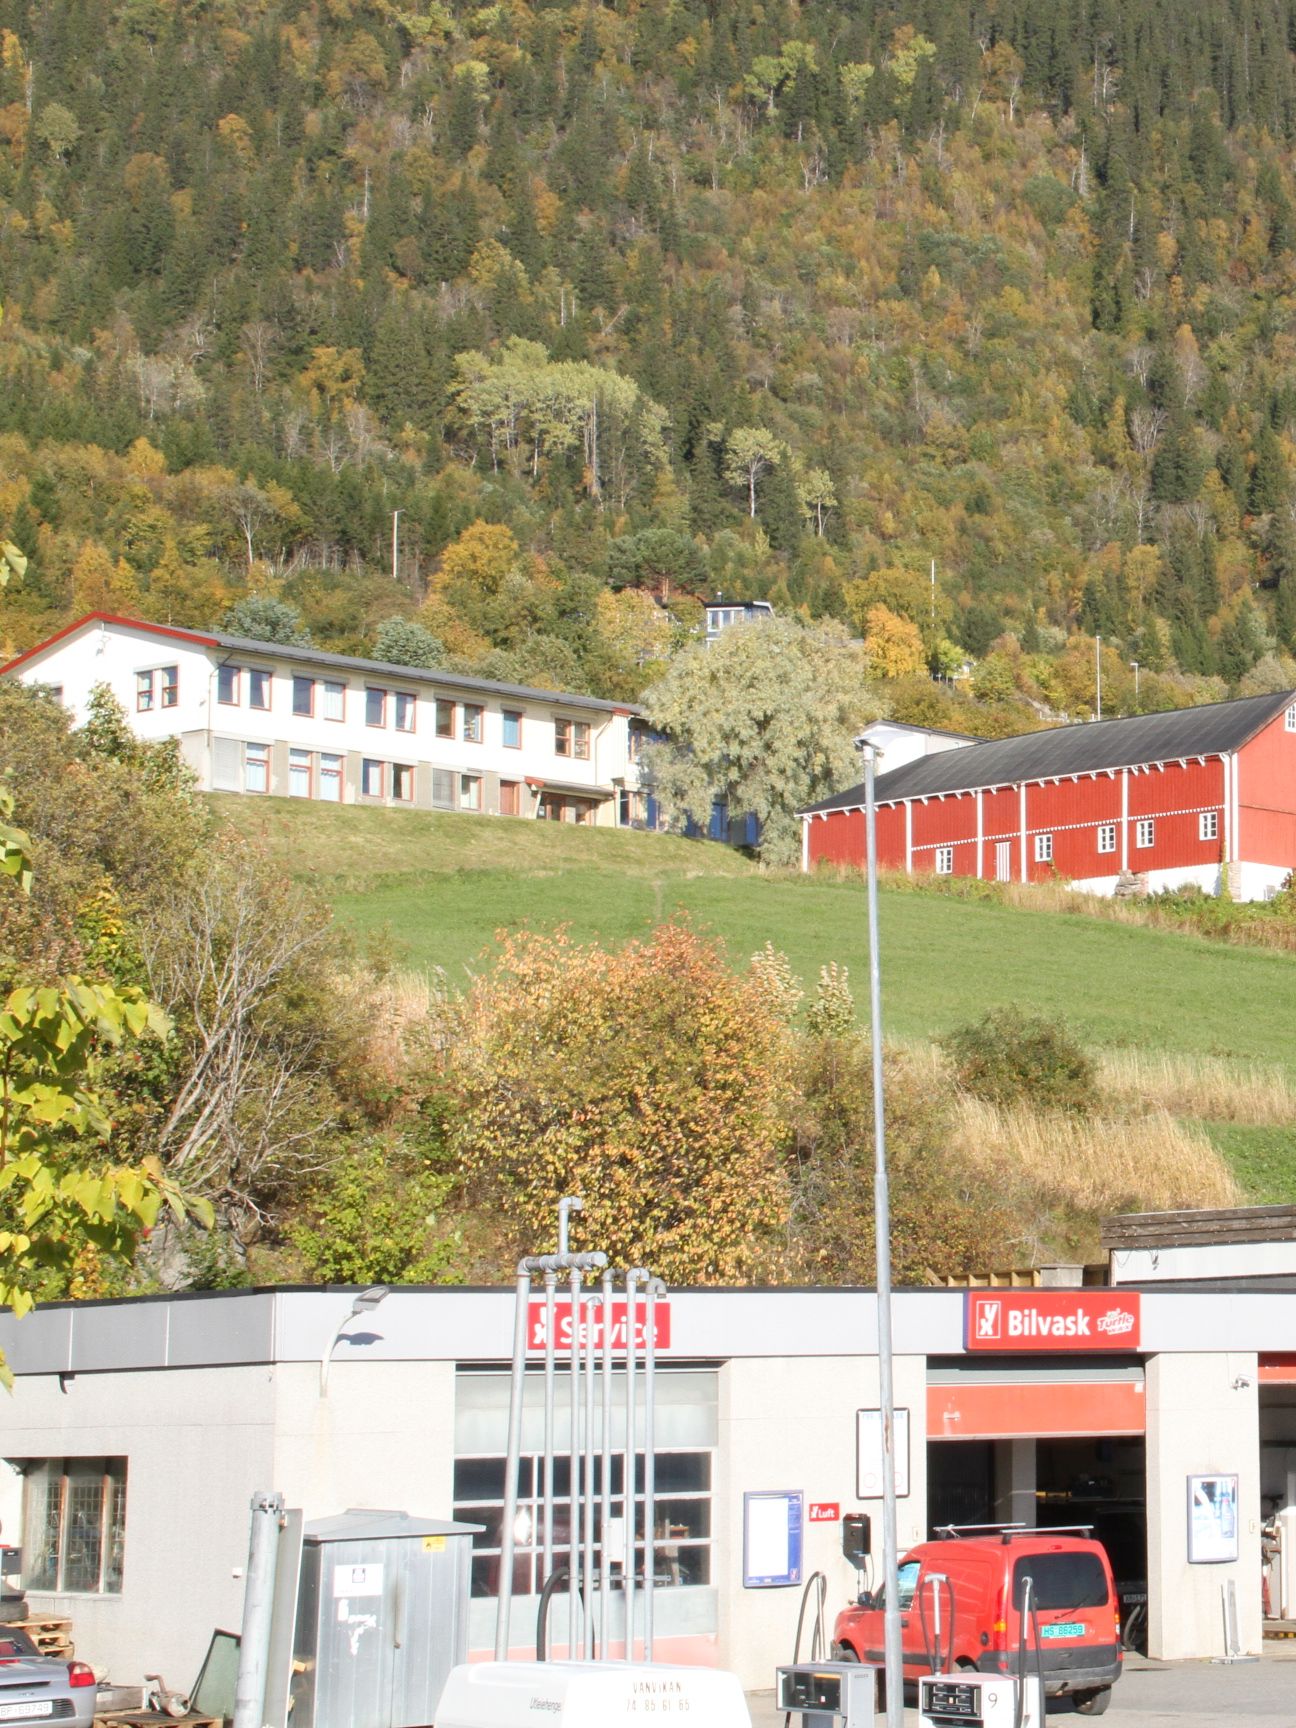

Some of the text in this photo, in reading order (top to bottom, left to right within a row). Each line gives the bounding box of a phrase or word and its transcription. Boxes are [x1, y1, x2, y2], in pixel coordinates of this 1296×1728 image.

[560, 1316, 658, 1344] Service
[1008, 1309, 1091, 1336] Bilvask
[1097, 1312, 1135, 1331] Turtle
[819, 1507, 835, 1519] Luft
[1043, 1626, 1054, 1636] HS
[988, 1692, 998, 1710] 9
